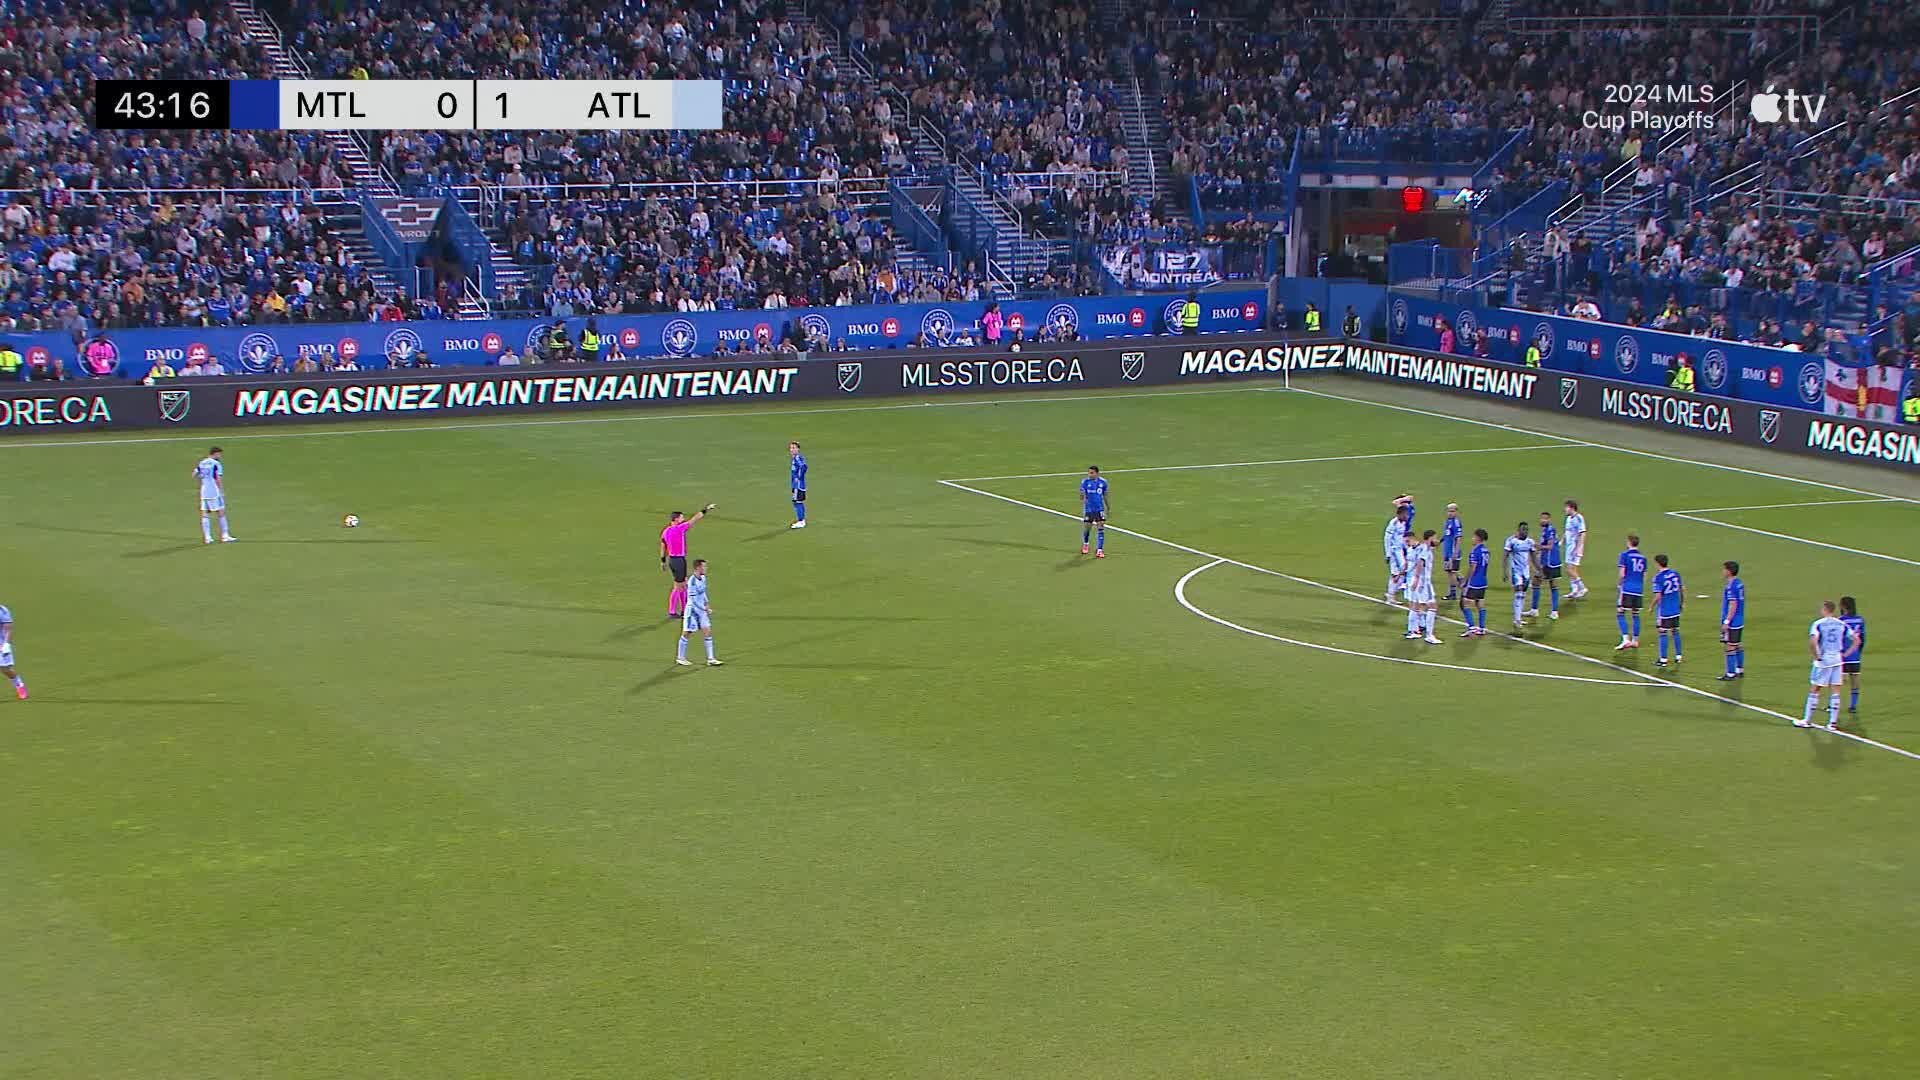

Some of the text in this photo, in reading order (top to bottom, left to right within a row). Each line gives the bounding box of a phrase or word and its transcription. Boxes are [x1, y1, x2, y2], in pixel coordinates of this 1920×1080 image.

[1159, 252, 1200, 270] 127
[1097, 313, 1126, 325] BMO
[1212, 308, 1239, 320] BMO
[719, 328, 750, 341] BMO
[847, 323, 879, 335] BMO
[444, 338, 479, 351] BMO
[1180, 344, 1345, 375] MAGASINEZ
[902, 357, 1084, 388] MLSSTORE.CA
[1741, 366, 1766, 381] BMO
[235, 383, 441, 418] MAGASINEZ
[1601, 387, 1733, 434] MLSSTORE.CA
[1807, 420, 1920, 464] MAGASIN
[1631, 558, 1645, 572] 16
[1663, 577, 1680, 595] 23
